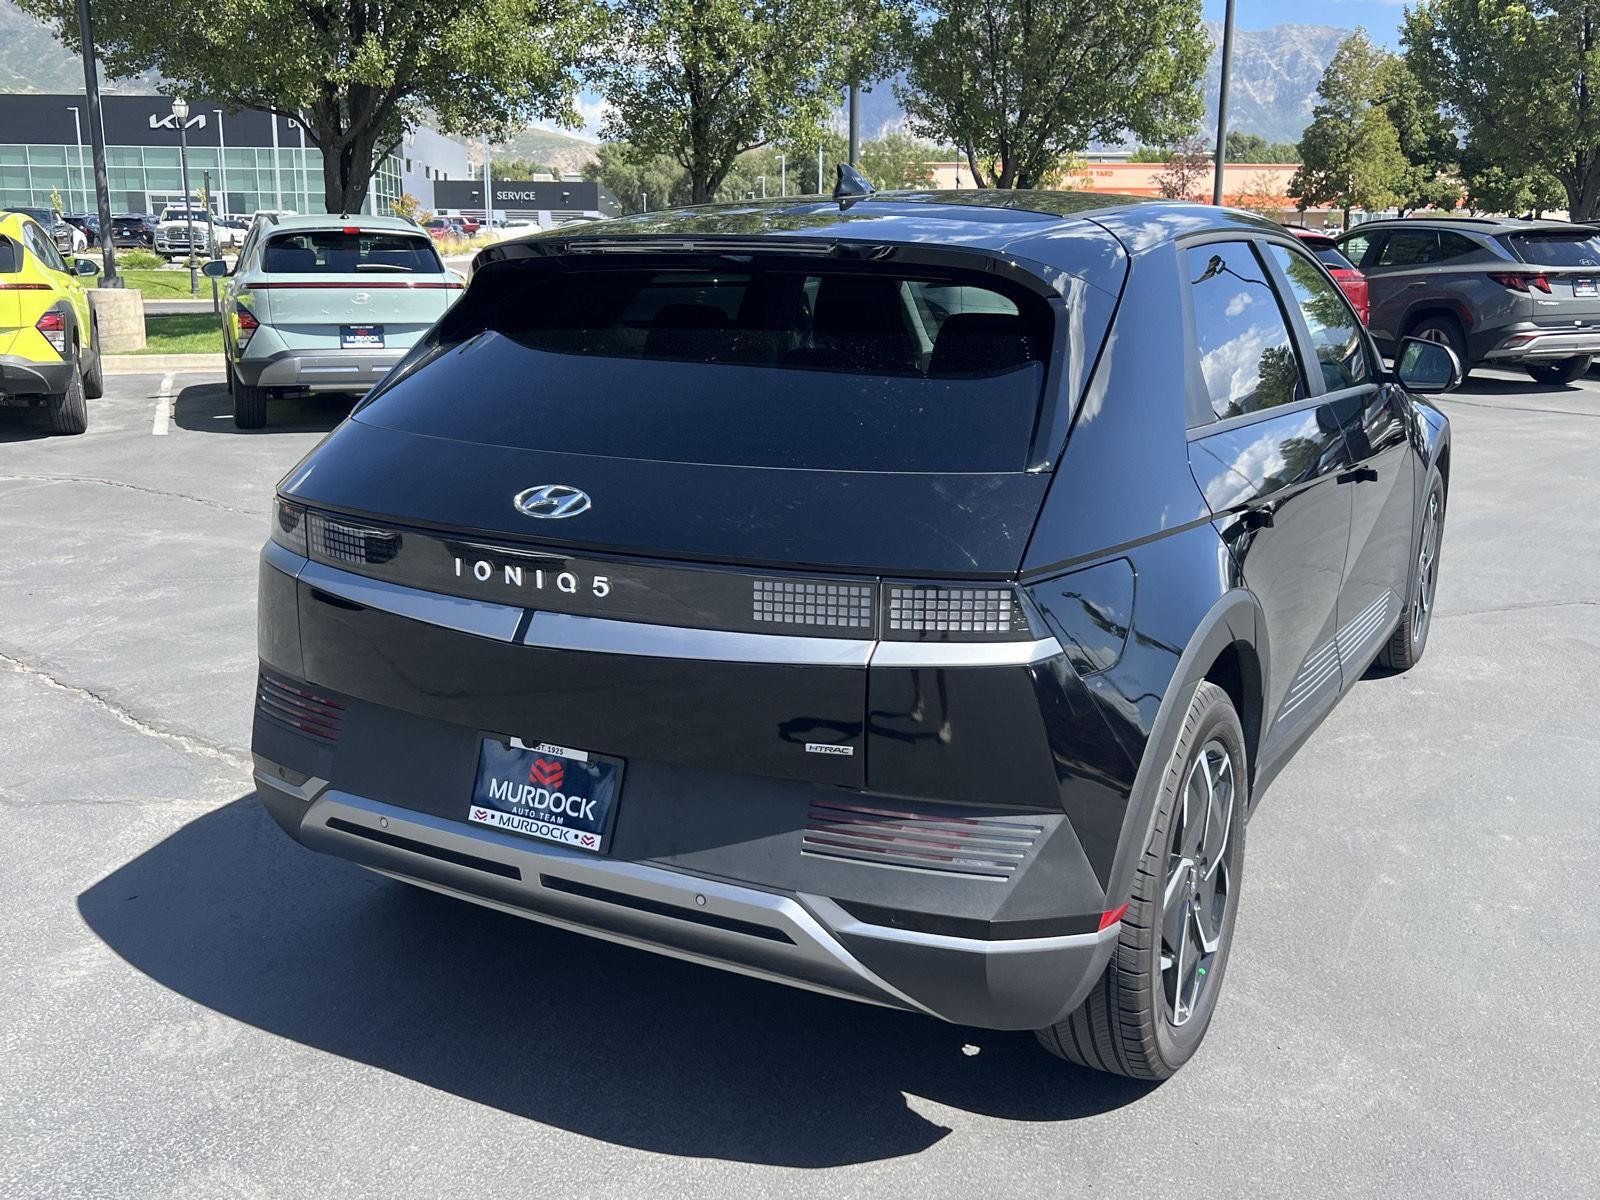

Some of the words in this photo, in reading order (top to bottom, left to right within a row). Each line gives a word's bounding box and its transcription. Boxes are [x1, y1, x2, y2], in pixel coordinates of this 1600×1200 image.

[496, 191, 536, 200] SERVICE
[454, 557, 577, 594] IONIQ
[592, 575, 611, 598] 5
[547, 746, 564, 756] 1925
[808, 744, 850, 754] HTRAC
[489, 777, 598, 821] MURDOCK
[511, 806, 536, 818] AUTO
[539, 812, 564, 825] TEAM
[498, 814, 571, 842] MURDOCK
